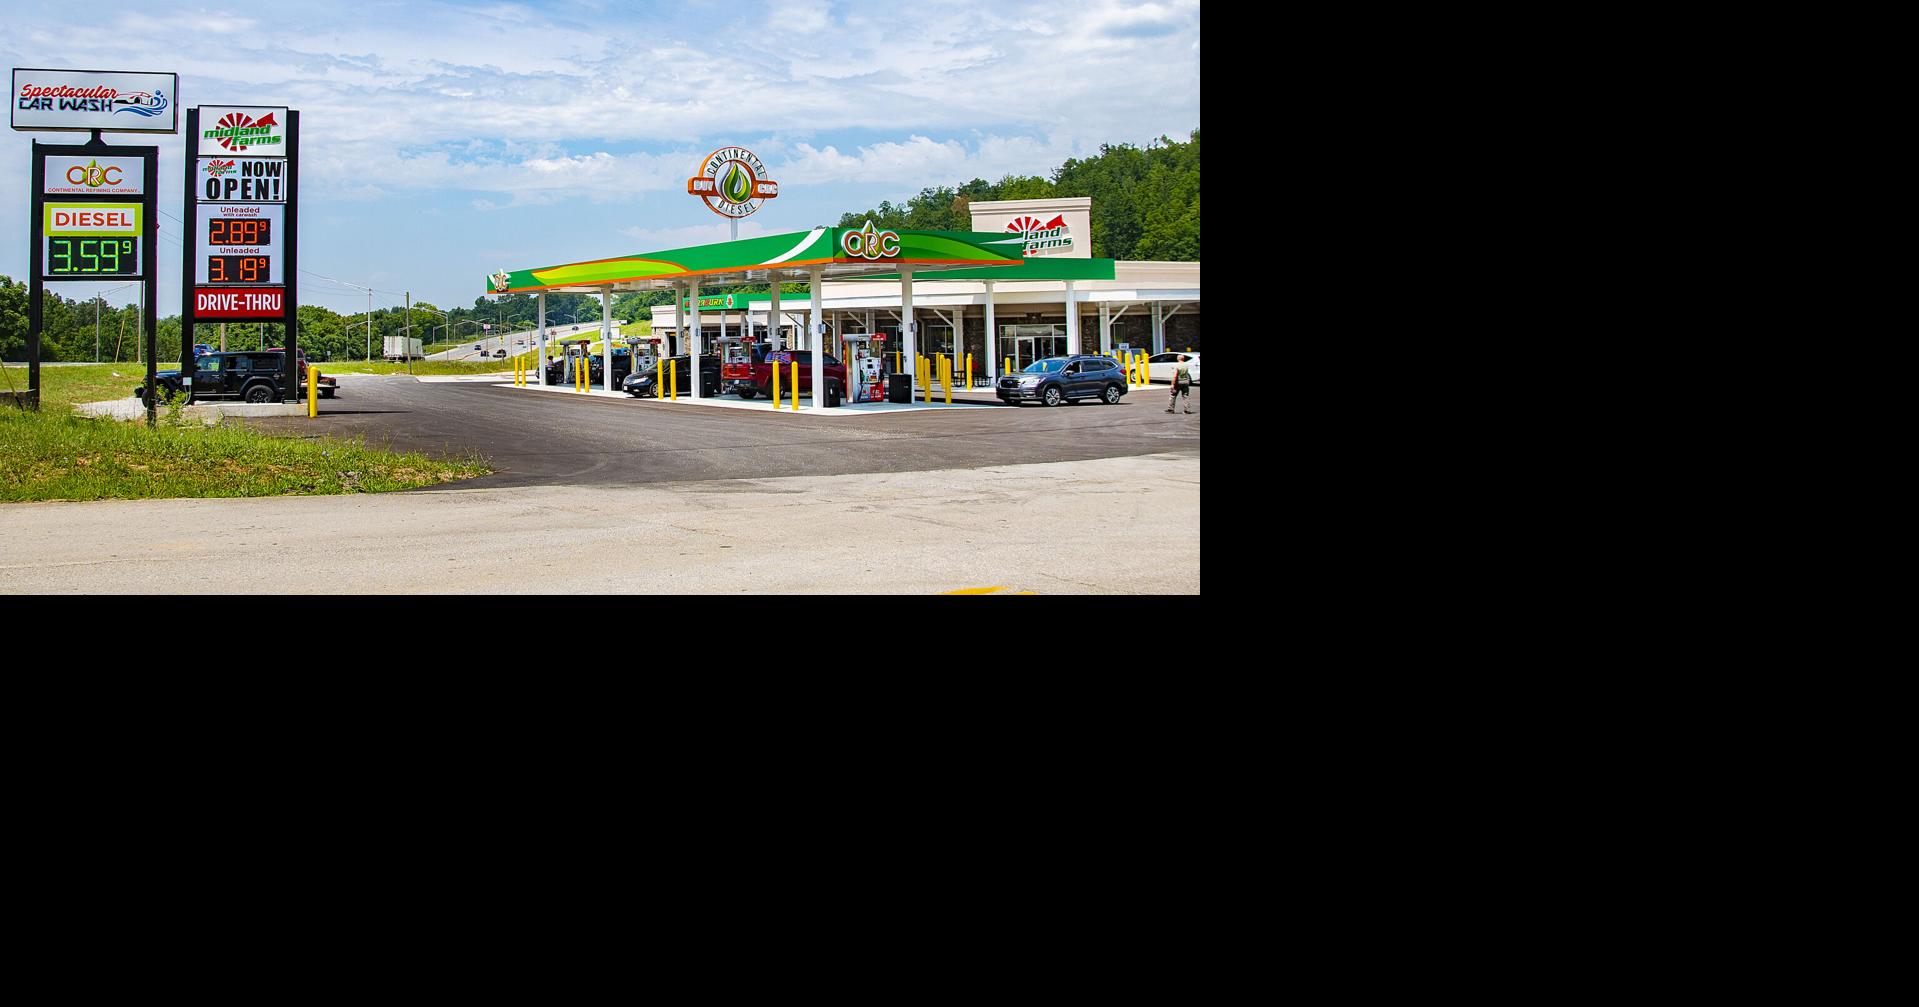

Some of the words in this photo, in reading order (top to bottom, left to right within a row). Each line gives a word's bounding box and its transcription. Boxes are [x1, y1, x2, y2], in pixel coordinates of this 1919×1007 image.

[20, 83, 118, 100] Spectacular
[19, 97, 53, 111] CAR
[59, 98, 113, 112] WASH
[203, 124, 271, 138] midland
[231, 135, 282, 146] farms
[241, 161, 282, 177] NOW
[706, 149, 766, 177] CONTINENTAL
[206, 178, 280, 200] OPEN!
[718, 200, 757, 214] DIESEL
[55, 212, 132, 227] DIESEL
[197, 293, 281, 311] DRIVE-THRU
